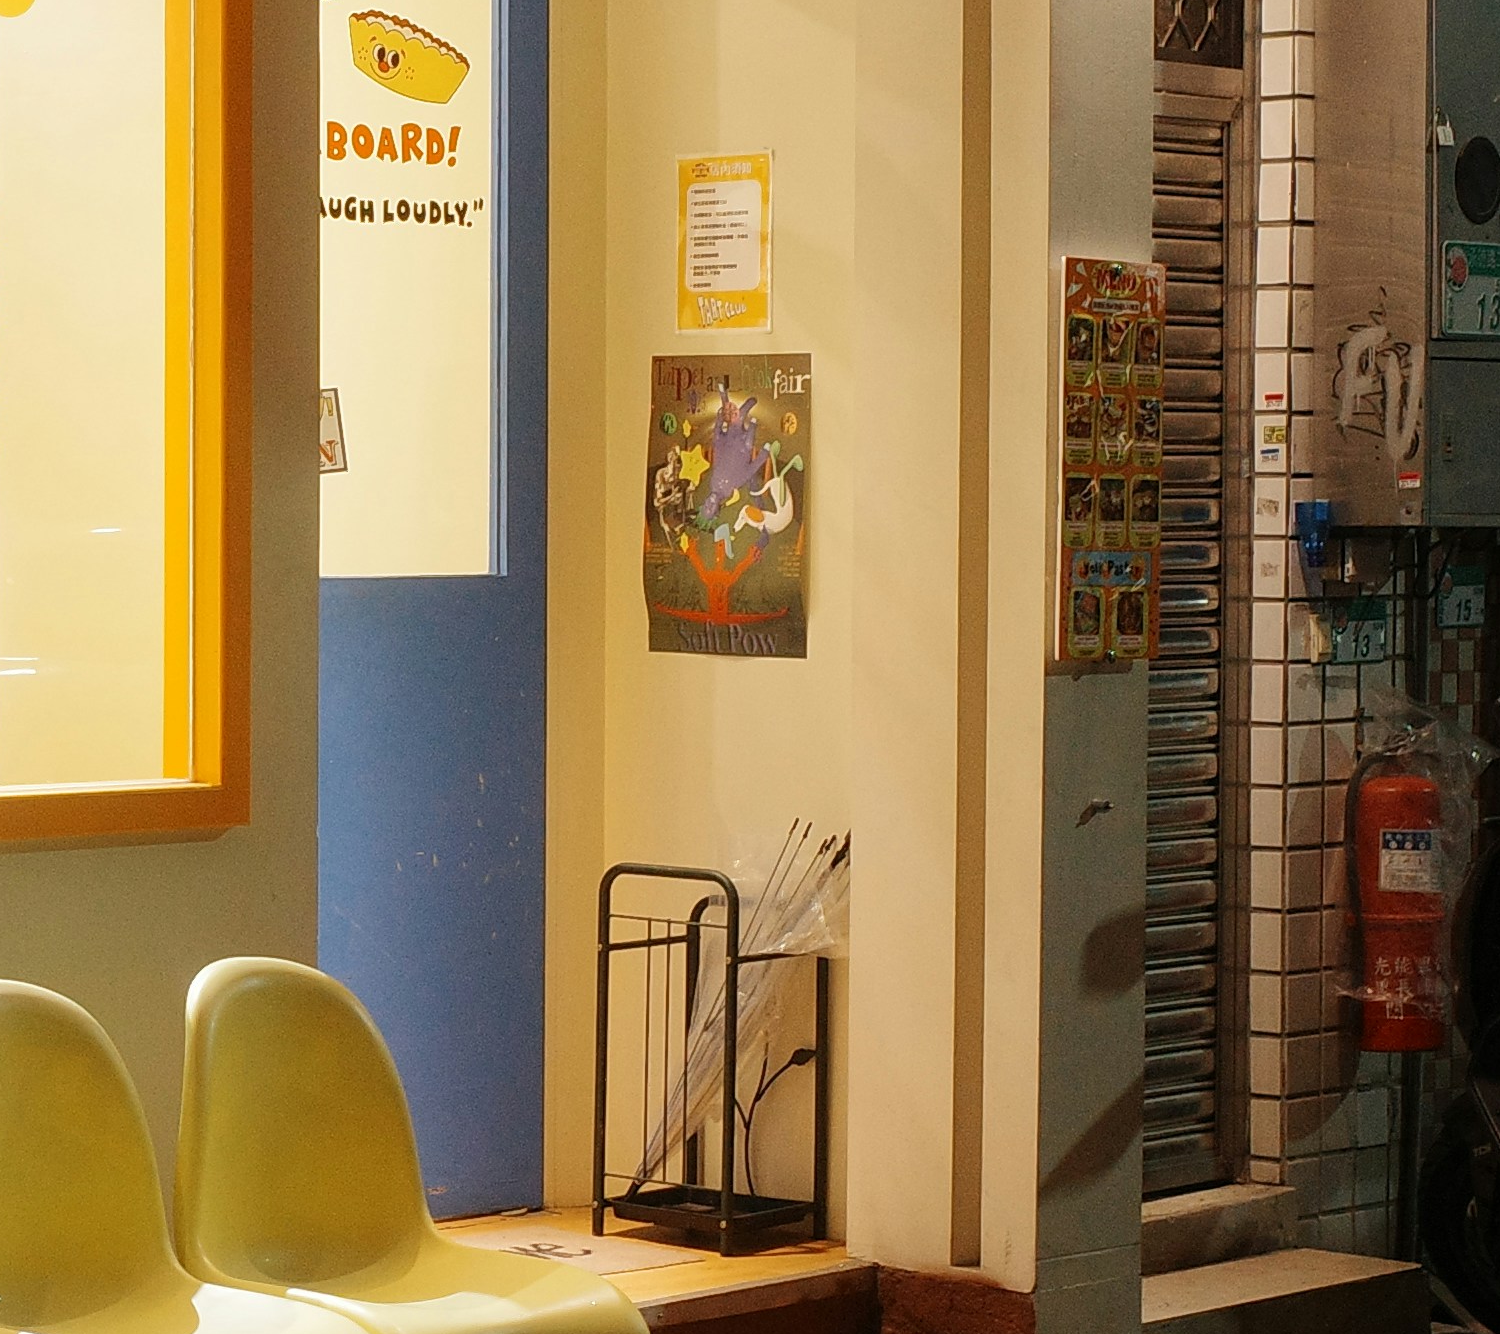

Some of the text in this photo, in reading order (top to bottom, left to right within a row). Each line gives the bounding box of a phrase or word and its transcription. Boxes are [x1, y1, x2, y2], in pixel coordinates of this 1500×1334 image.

[326, 120, 462, 168] BOARD!
[697, 296, 748, 326] TART CLUB
[772, 368, 812, 401] fair
[1456, 599, 1472, 622] 15
[677, 619, 719, 652] Soft
